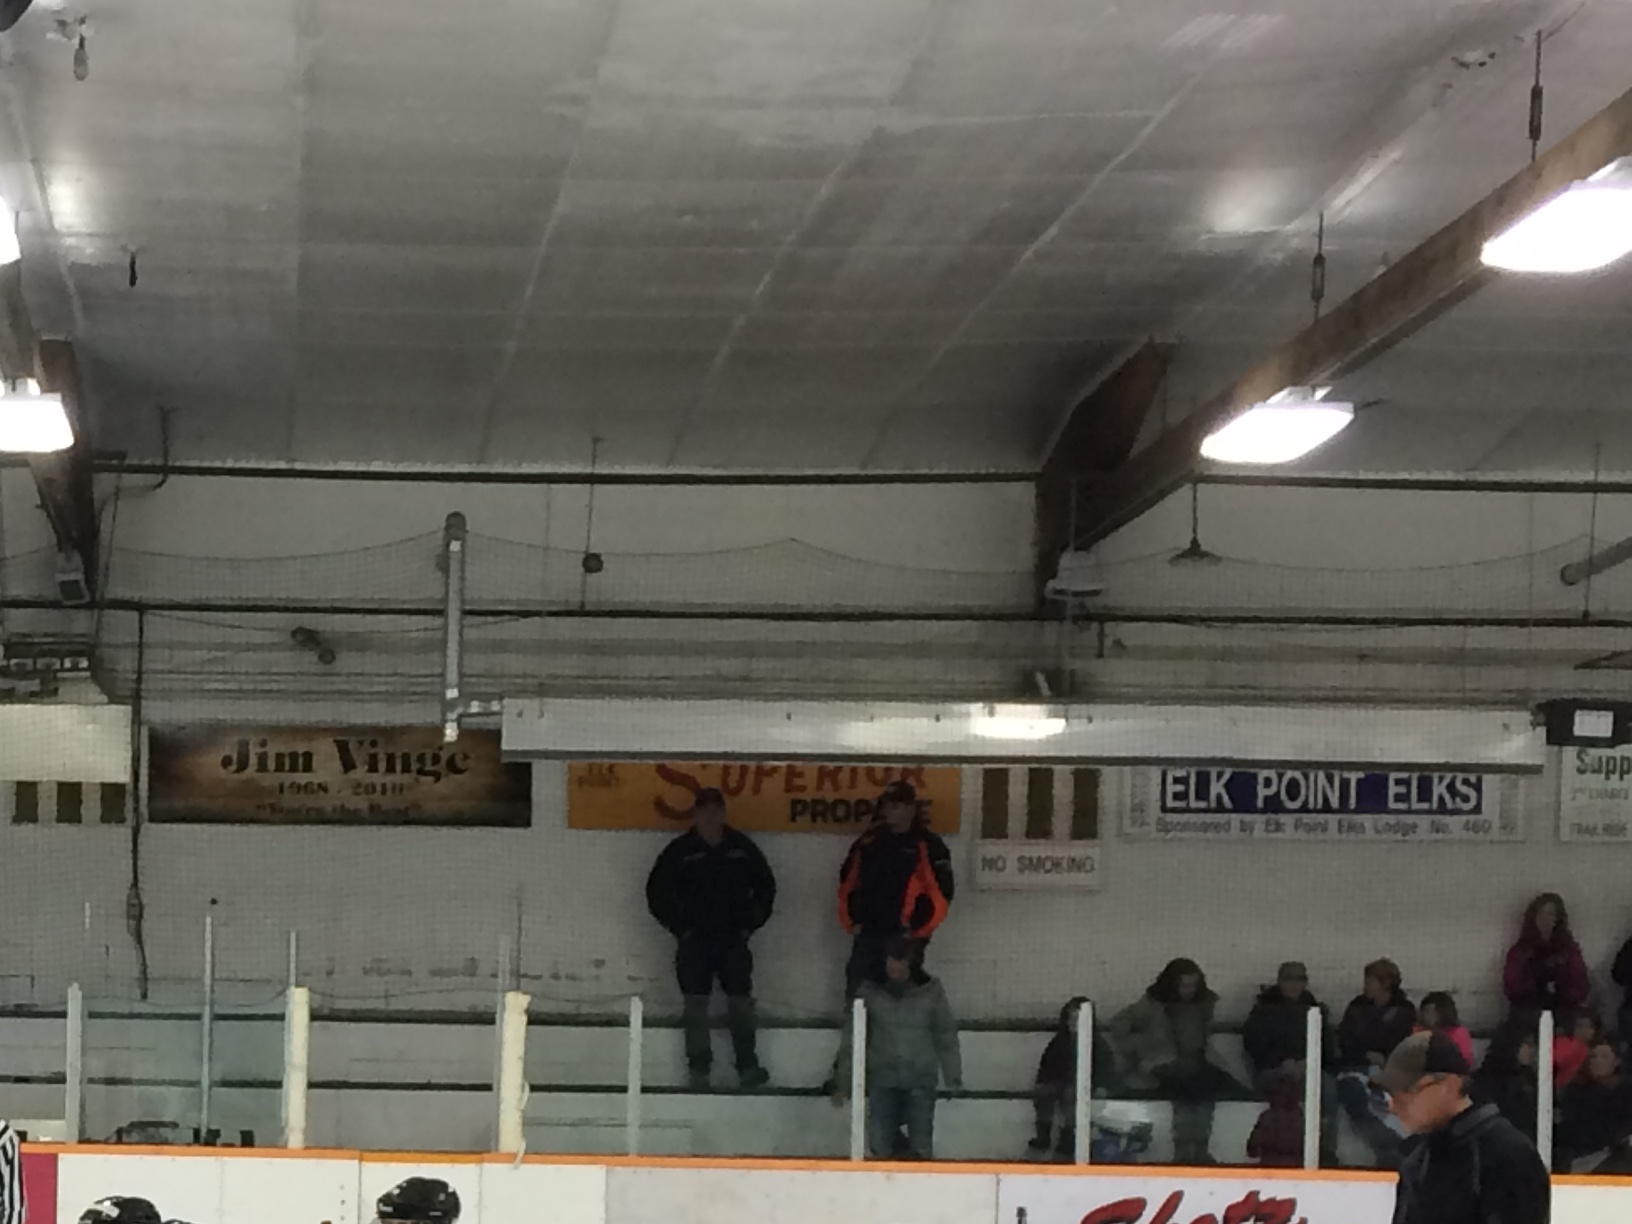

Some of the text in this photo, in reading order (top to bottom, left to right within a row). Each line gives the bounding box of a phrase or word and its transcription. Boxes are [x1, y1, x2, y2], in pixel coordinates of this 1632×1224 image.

[220, 739, 471, 784] Jim Vinge
[1165, 769, 1234, 809] ELK
[1256, 770, 1366, 811] POINT
[1387, 773, 1478, 811] ELKS
[1155, 817, 1232, 835] Sponsored
[1240, 817, 1256, 836] by
[1374, 817, 1419, 837] Lodge
[980, 854, 1096, 874] NO SMOKING
